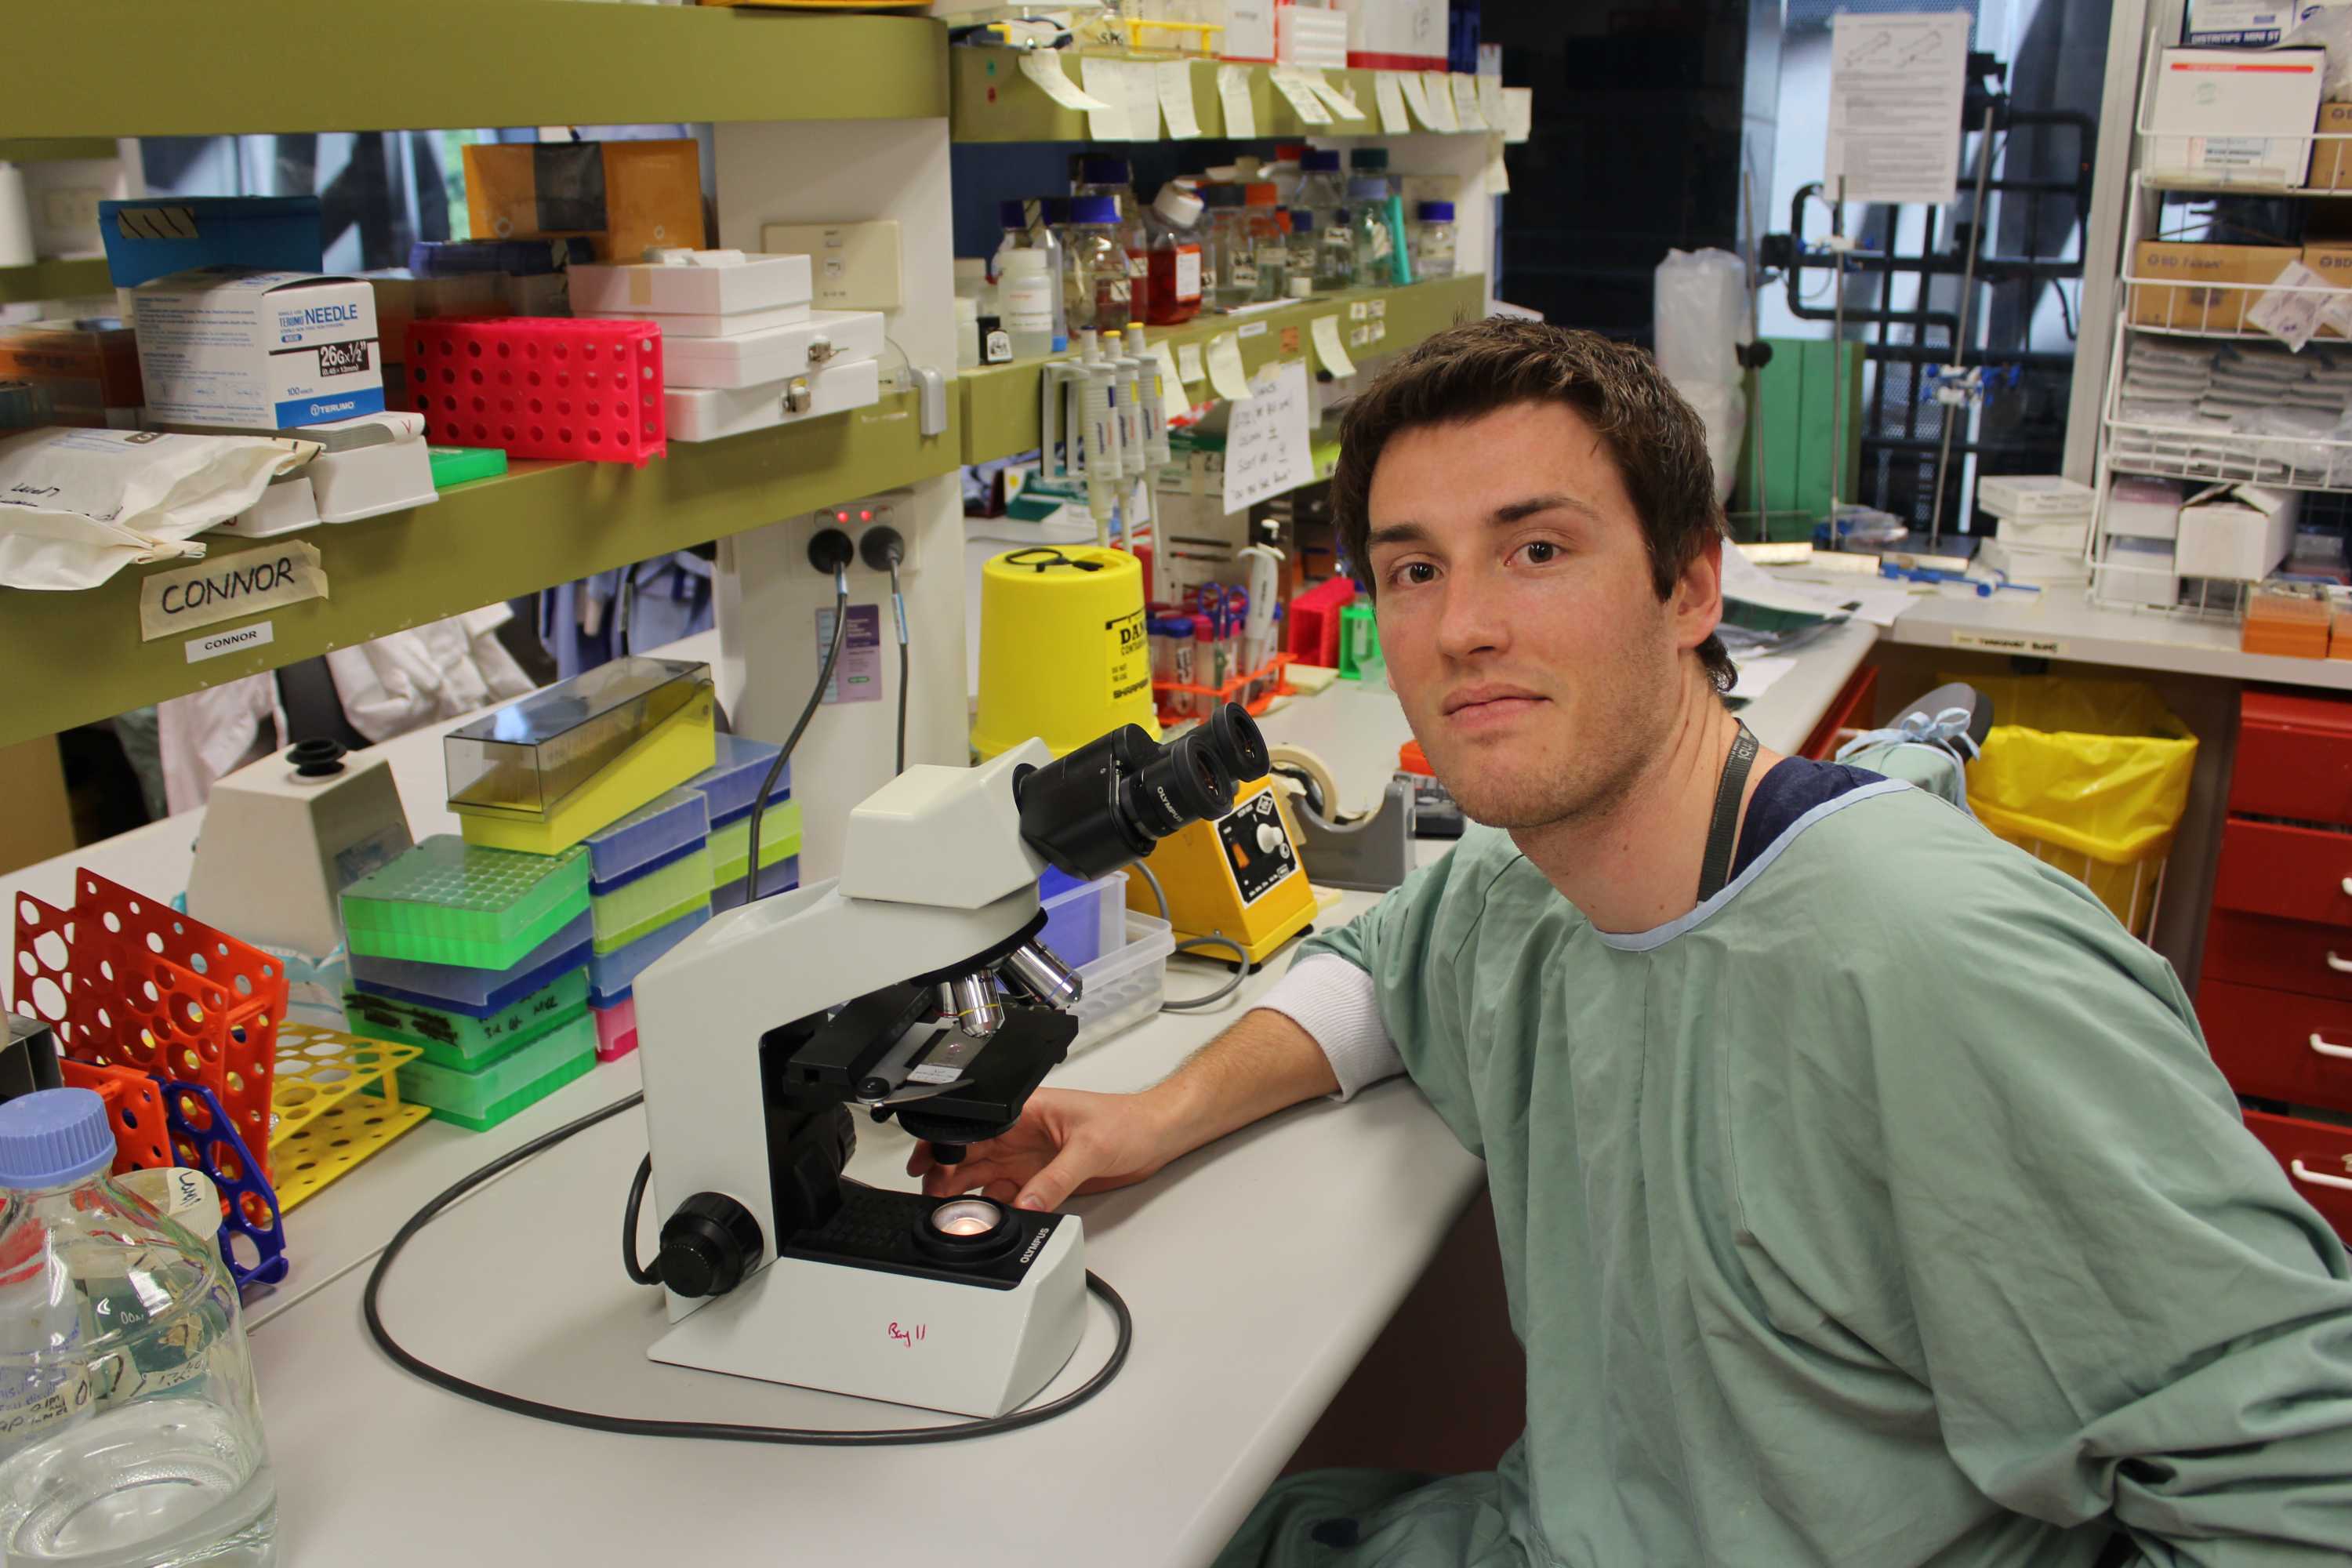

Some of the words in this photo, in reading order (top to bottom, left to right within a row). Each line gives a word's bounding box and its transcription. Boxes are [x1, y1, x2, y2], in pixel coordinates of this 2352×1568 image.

[305, 304, 358, 325] NEEDLE
[287, 387, 299, 396] 100
[320, 401, 354, 413] TERUMO
[162, 557, 295, 614] CONNOR
[205, 630, 257, 651] CONNOR
[1157, 786, 1185, 823] OLYMPUS
[1020, 1228, 1050, 1264] OLYMPUS
